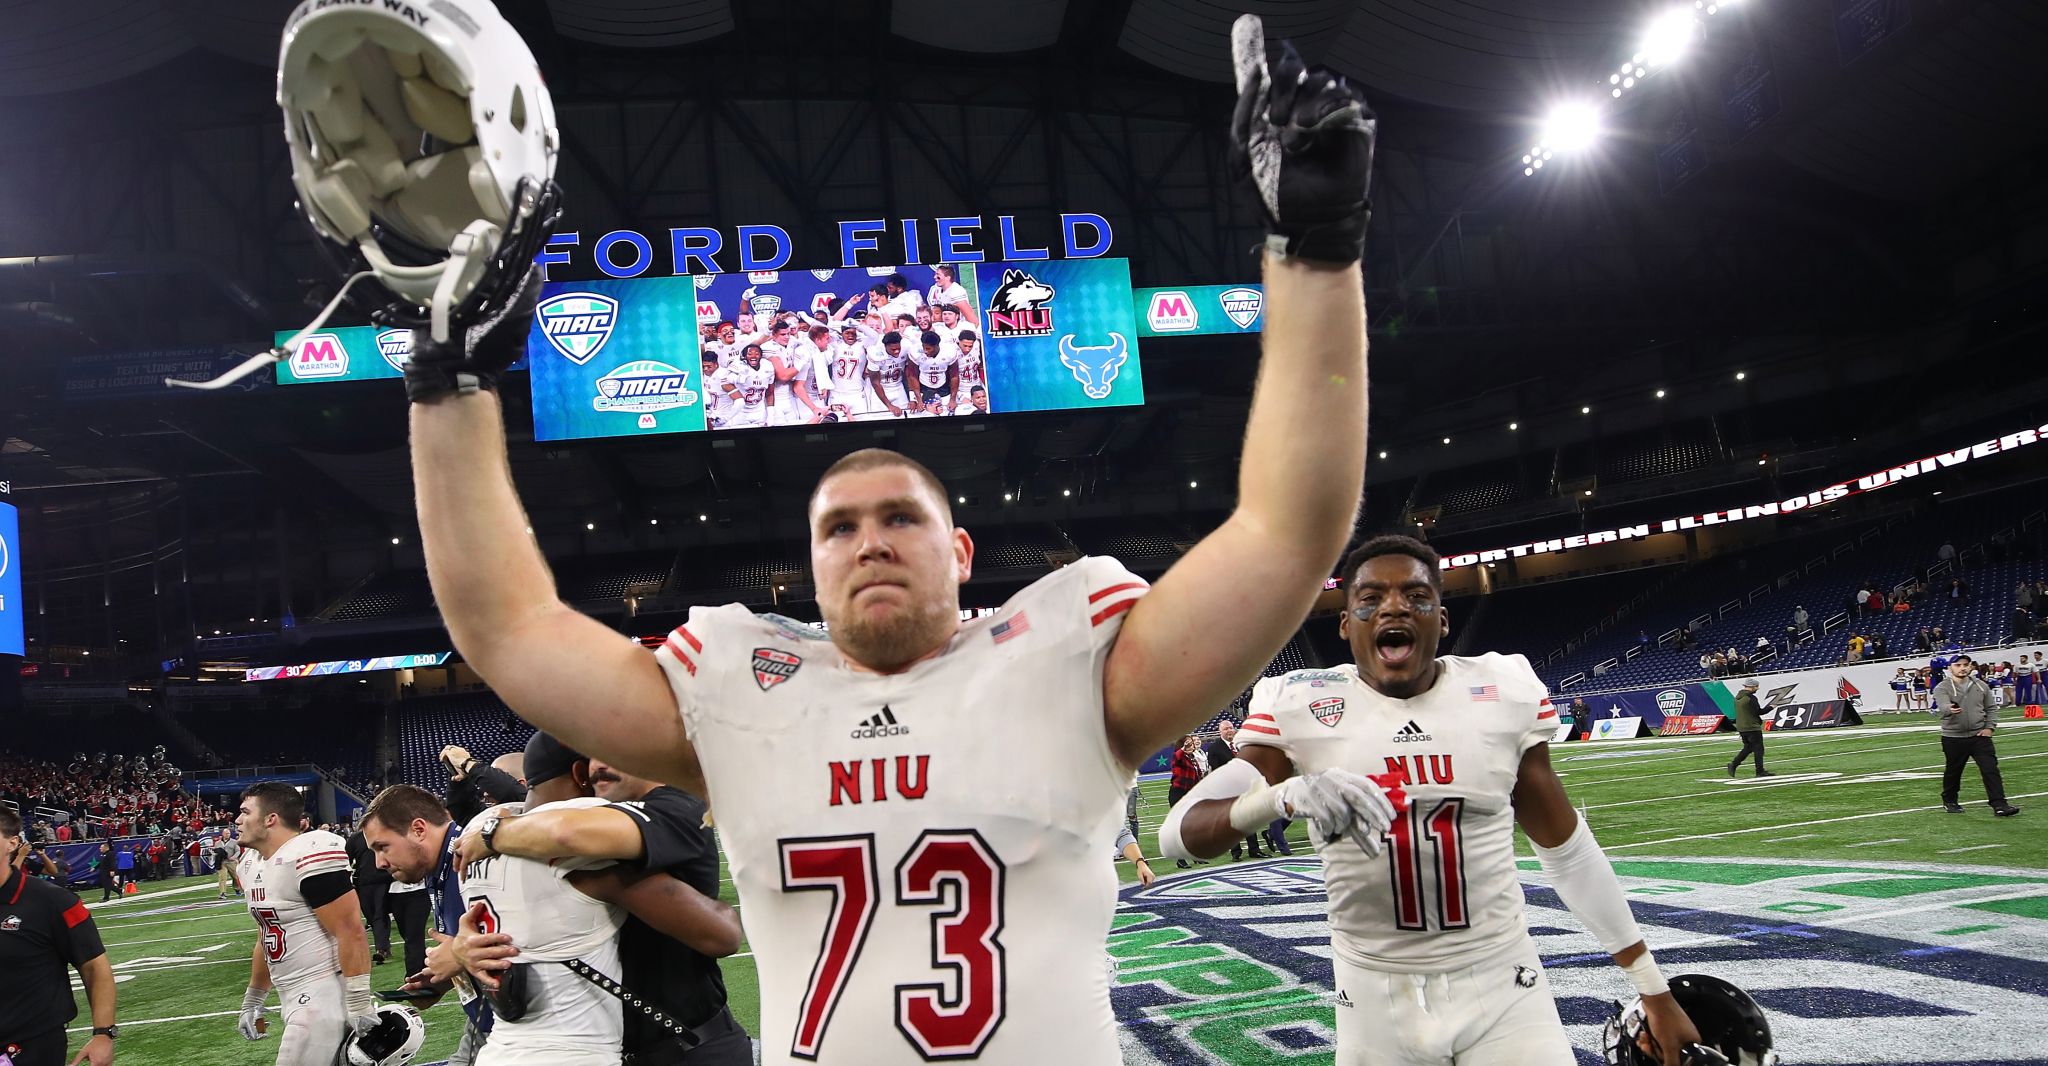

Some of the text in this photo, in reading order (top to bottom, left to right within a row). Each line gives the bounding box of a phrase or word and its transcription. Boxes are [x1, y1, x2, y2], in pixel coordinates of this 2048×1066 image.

[383, 0, 429, 27] WAY
[533, 213, 1113, 282] FORD FIELD
[1157, 298, 1188, 317] M
[1224, 300, 1259, 313] MAC
[545, 314, 613, 335] MAC
[991, 309, 1050, 331] NIU
[300, 341, 338, 363] M
[382, 342, 411, 354] MA
[115, 366, 141, 376] TEXT
[185, 360, 212, 371] WITH
[298, 362, 340, 371] MARATHON
[837, 358, 860, 380] 37
[108, 375, 158, 389] LOCATION
[620, 377, 684, 396] MAC
[597, 393, 695, 409] CHAMPIONSHIP
[1661, 484, 1849, 533] ILLINOIS
[286, 654, 437, 677] 30 29 0:00
[752, 658, 797, 675] MAC
[1313, 704, 1345, 718] MAC
[1660, 700, 1685, 710] MAC
[2025, 705, 2037, 718] 30
[850, 725, 910, 739] adidas
[1392, 733, 1432, 743] adidas
[1384, 754, 1454, 786] NIU
[828, 754, 931, 806] NIU
[1381, 796, 1471, 932] 11
[251, 887, 266, 902] NIU
[777, 828, 1006, 1062] 73
